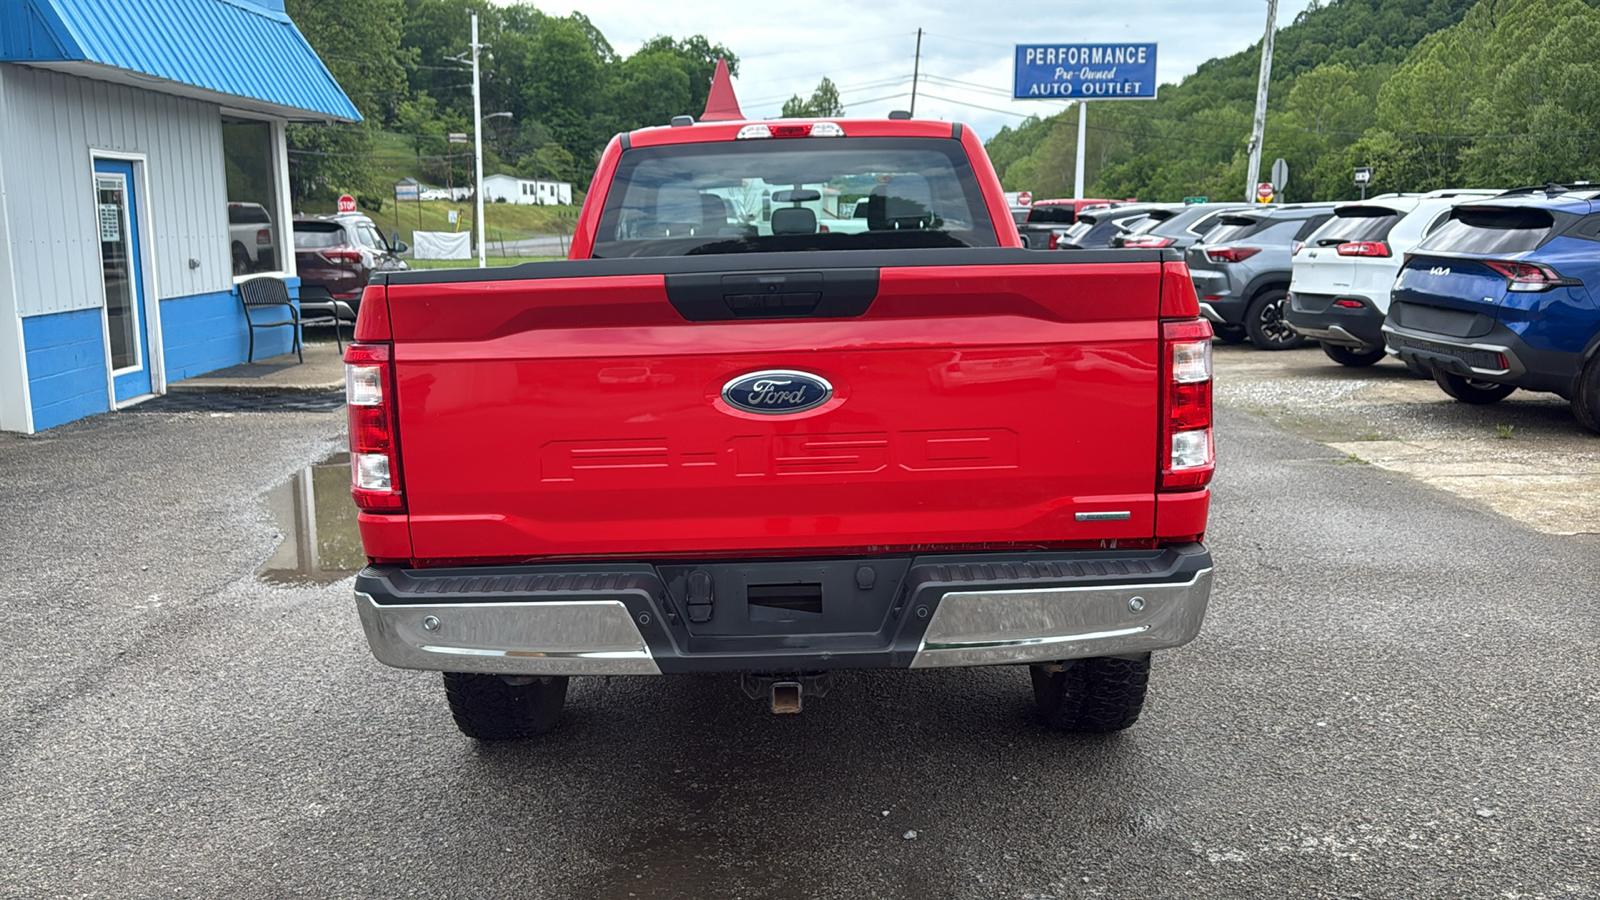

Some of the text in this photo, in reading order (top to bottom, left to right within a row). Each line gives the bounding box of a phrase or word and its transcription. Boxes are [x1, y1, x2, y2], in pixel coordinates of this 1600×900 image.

[1026, 46, 1147, 65] PERFORMANCE
[1054, 66, 1117, 80] Pre-Owned
[1029, 82, 1142, 95] AUTO OUTLET
[340, 201, 355, 210] STOP
[747, 379, 807, 405] Ford
[540, 427, 1020, 482] F-150
